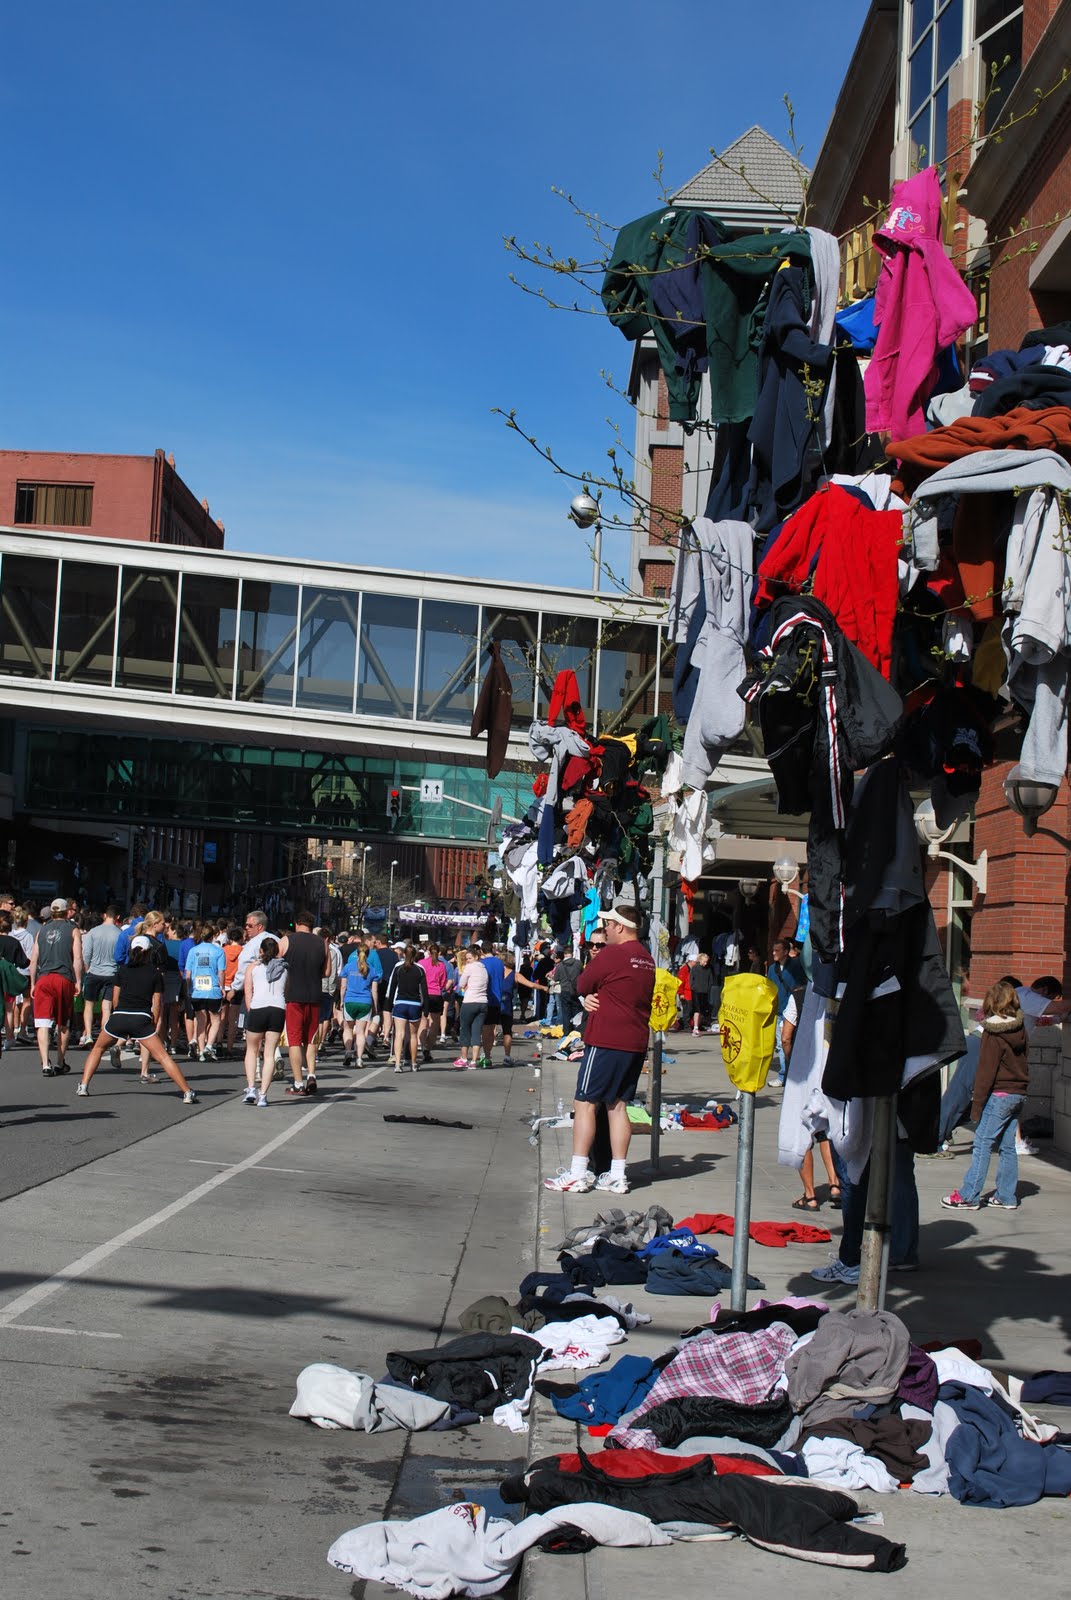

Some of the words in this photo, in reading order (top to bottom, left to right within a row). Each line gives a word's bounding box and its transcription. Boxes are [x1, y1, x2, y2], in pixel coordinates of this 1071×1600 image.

[416, 913, 454, 923] BLOOMSDAY
[724, 1002, 749, 1016] PARKING
[722, 1010, 745, 1023] SUNDAY
